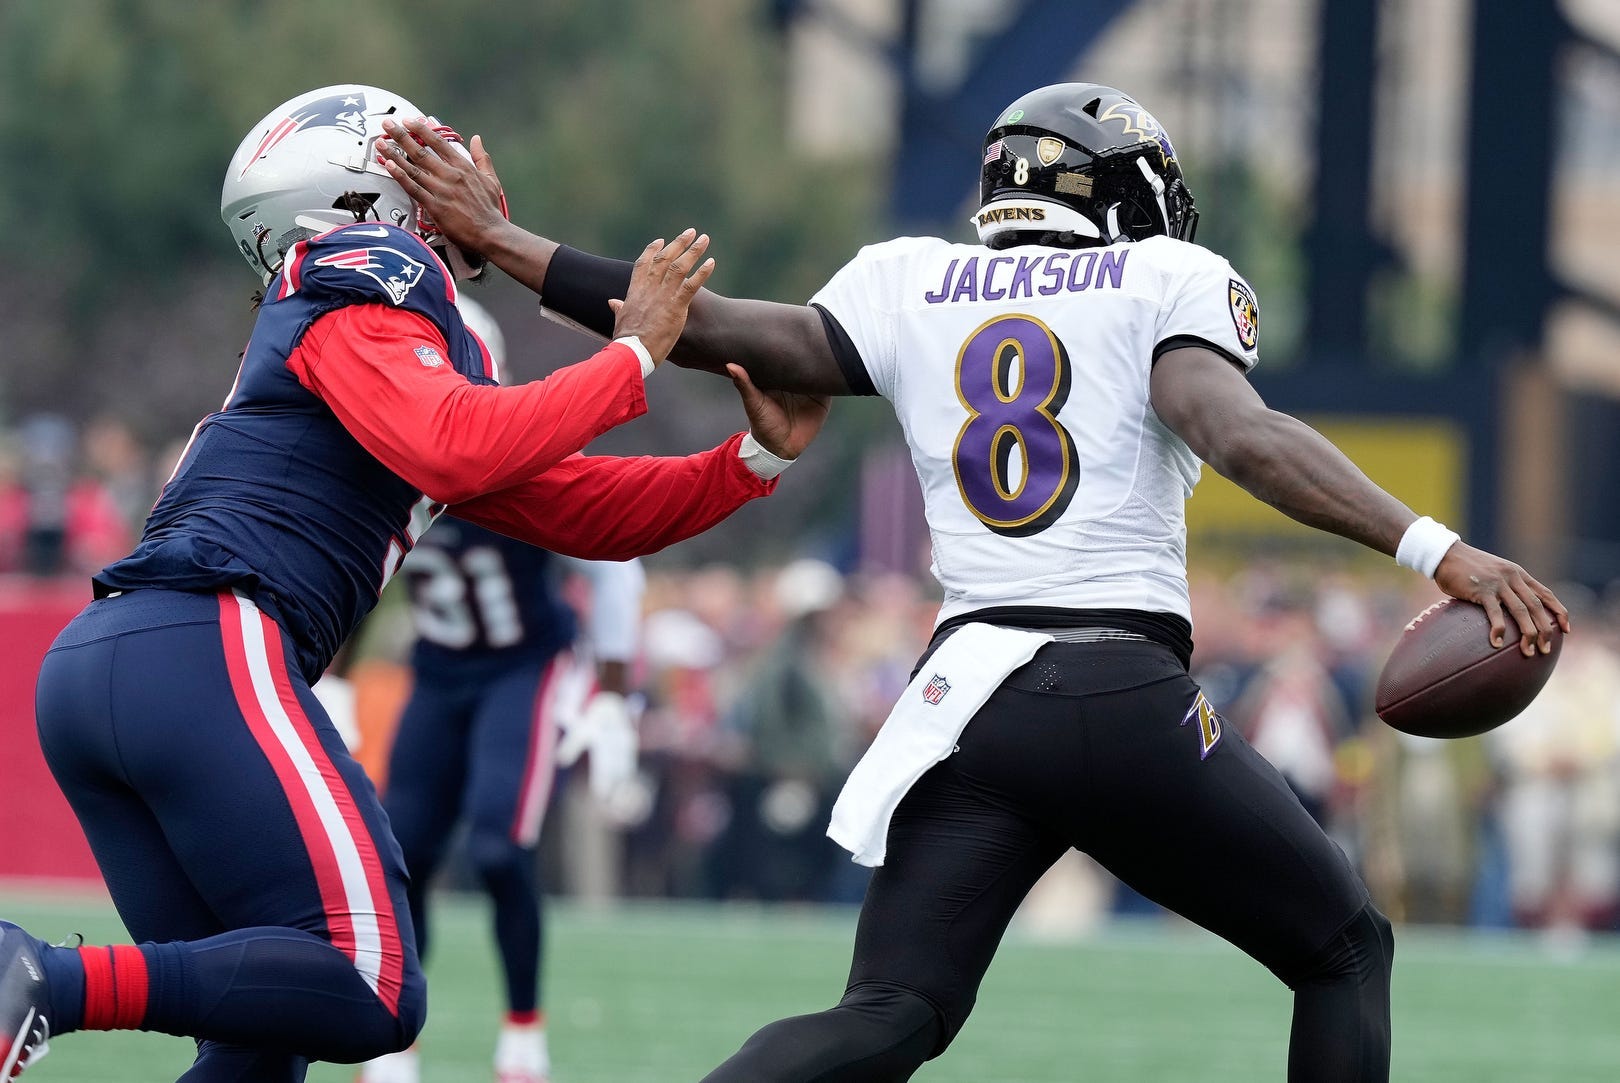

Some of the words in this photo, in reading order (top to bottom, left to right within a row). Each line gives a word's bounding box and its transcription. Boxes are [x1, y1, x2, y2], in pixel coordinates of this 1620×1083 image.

[1013, 157, 1029, 185] 8
[978, 207, 1046, 227] RAVENS
[925, 249, 1130, 304] JACKSON
[952, 313, 1081, 538] 8
[402, 545, 524, 650] 31
[924, 683, 942, 704] NFL
